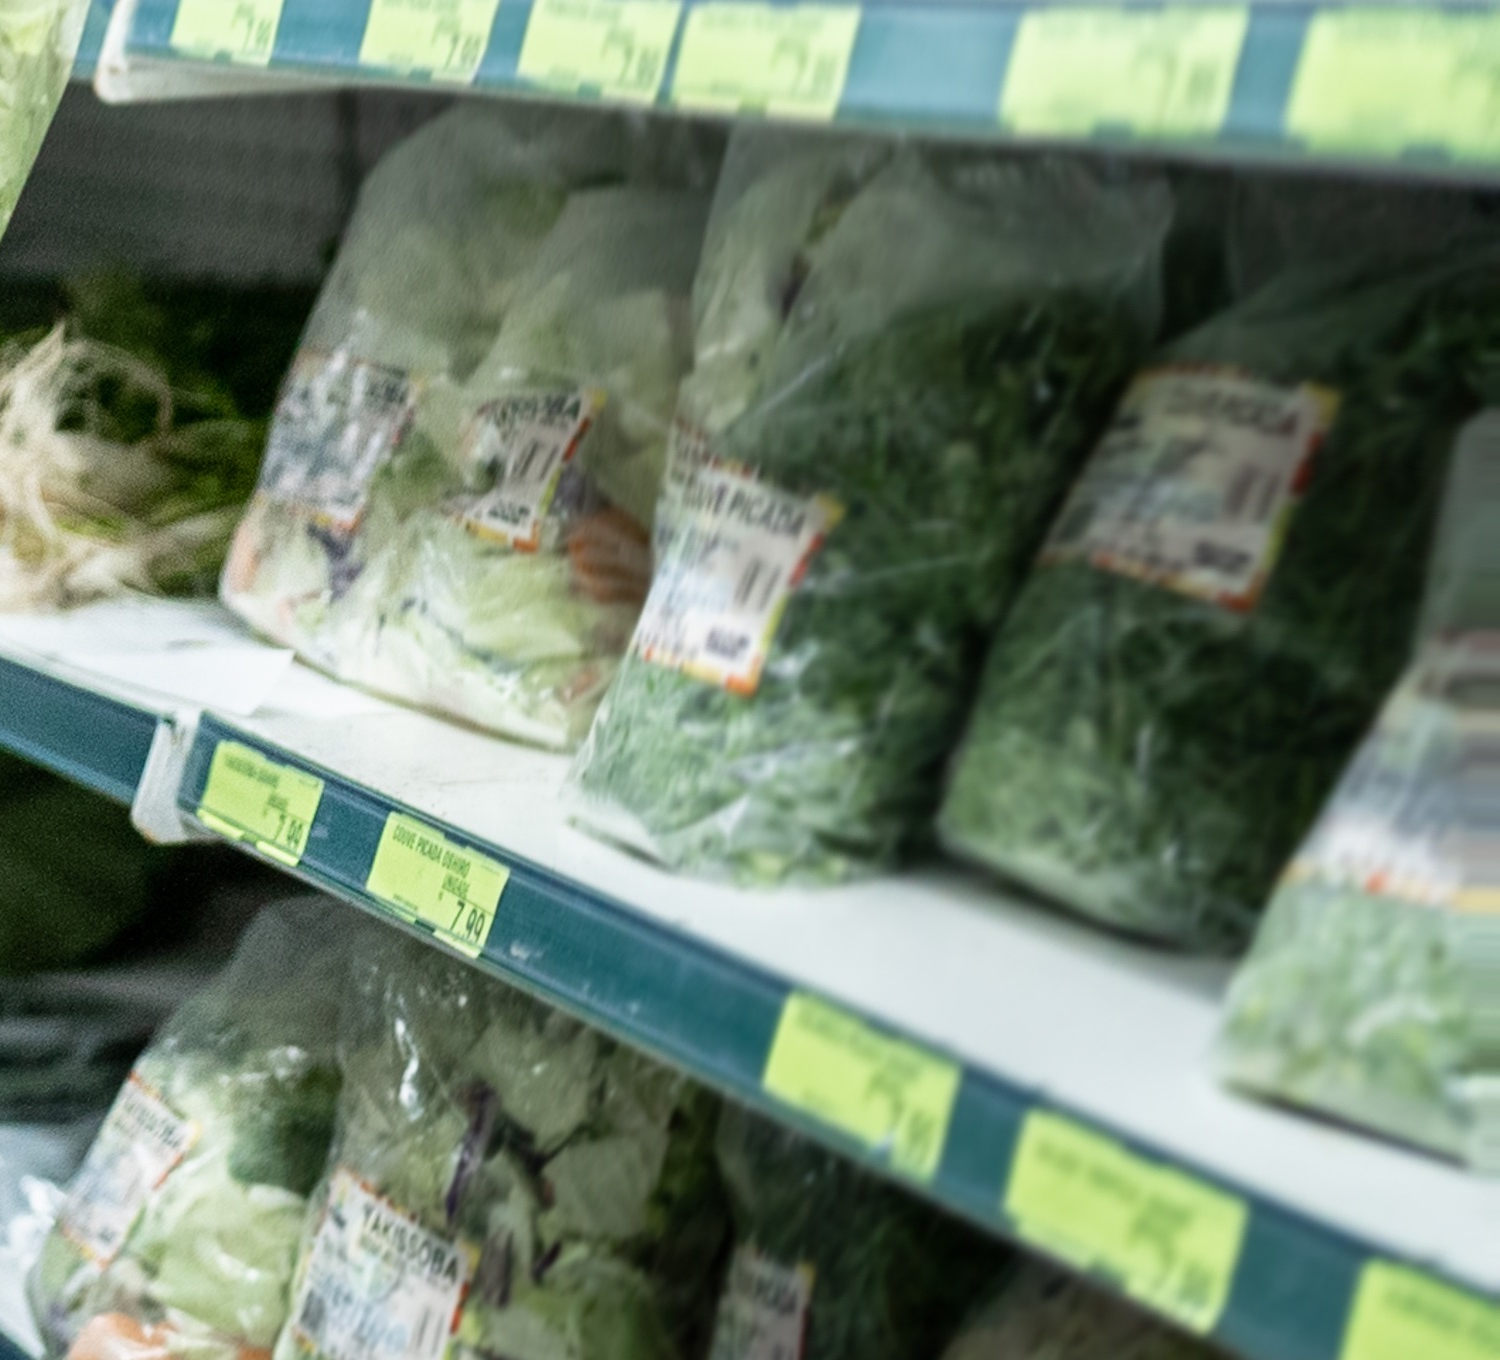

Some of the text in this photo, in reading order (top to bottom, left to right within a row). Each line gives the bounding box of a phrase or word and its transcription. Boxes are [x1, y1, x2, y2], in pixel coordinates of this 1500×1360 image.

[729, 488, 808, 539] PICADA
[415, 834, 444, 863] PICADA
[360, 1200, 461, 1285] YAKISSOBA
